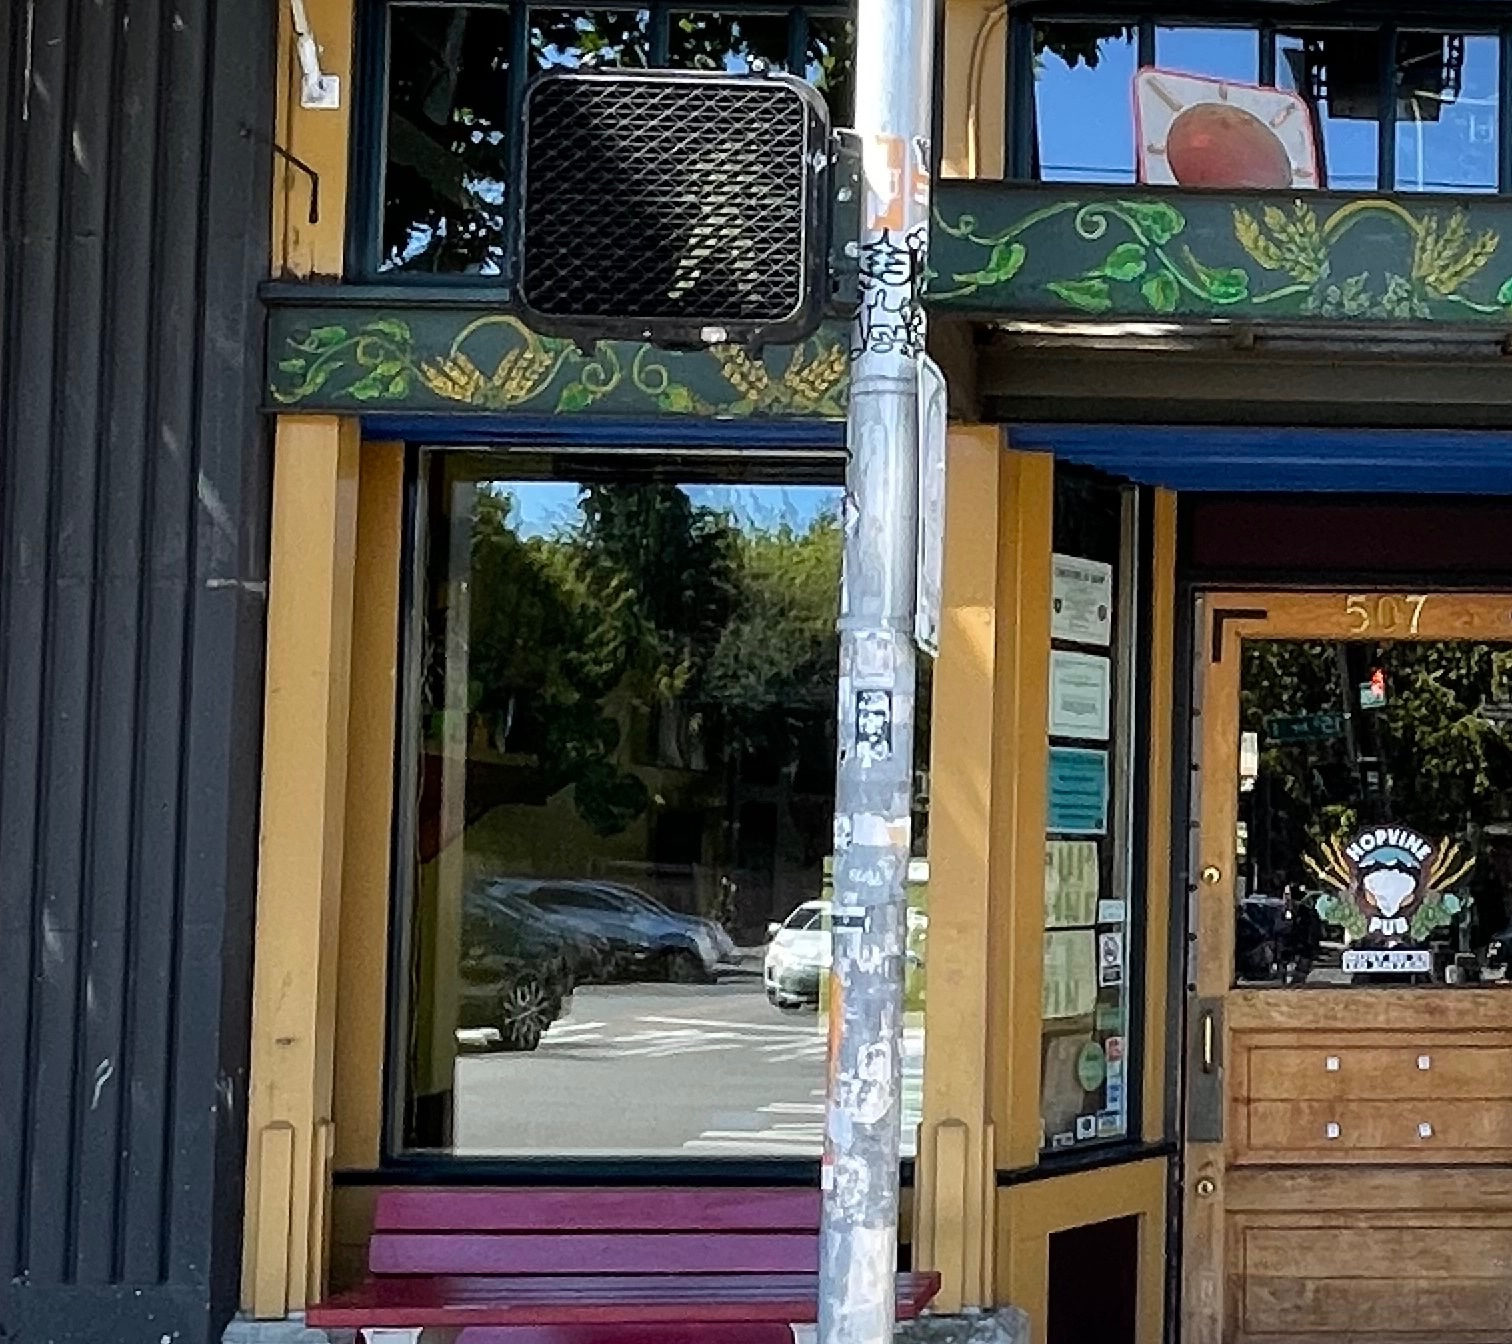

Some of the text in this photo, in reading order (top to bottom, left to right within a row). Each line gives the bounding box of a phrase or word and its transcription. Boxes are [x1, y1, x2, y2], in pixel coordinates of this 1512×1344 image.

[1346, 595, 1428, 634] 507
[1346, 828, 1432, 862] HOPVINE
[1368, 916, 1409, 936] PUB
